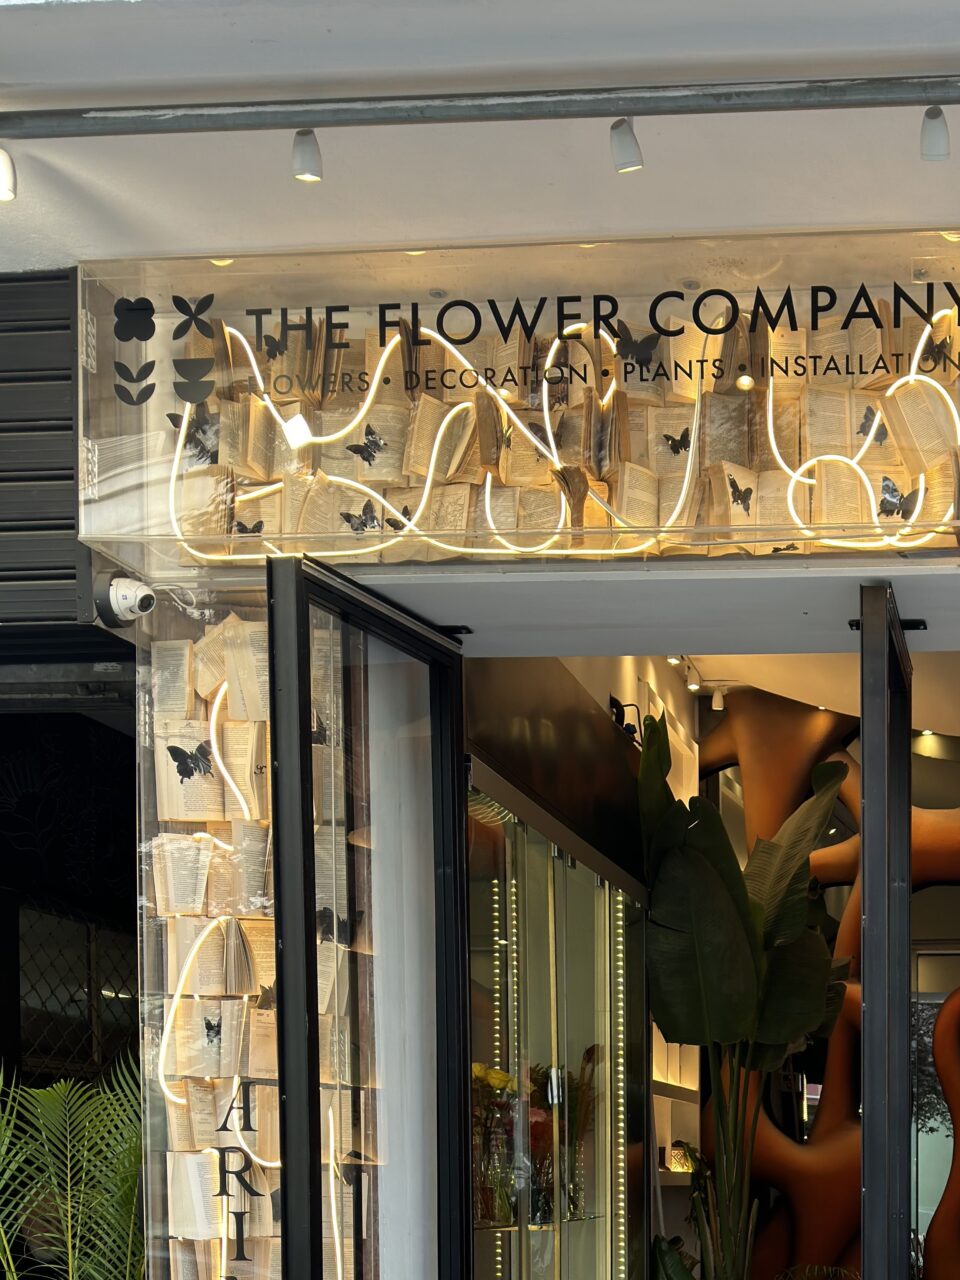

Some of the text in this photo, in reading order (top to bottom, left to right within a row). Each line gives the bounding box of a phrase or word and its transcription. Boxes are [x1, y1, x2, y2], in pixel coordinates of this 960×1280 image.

[245, 304, 351, 353] THE
[378, 294, 622, 348] FLOWER
[404, 363, 588, 390] DECORATION
[623, 358, 725, 383] PLANTS
